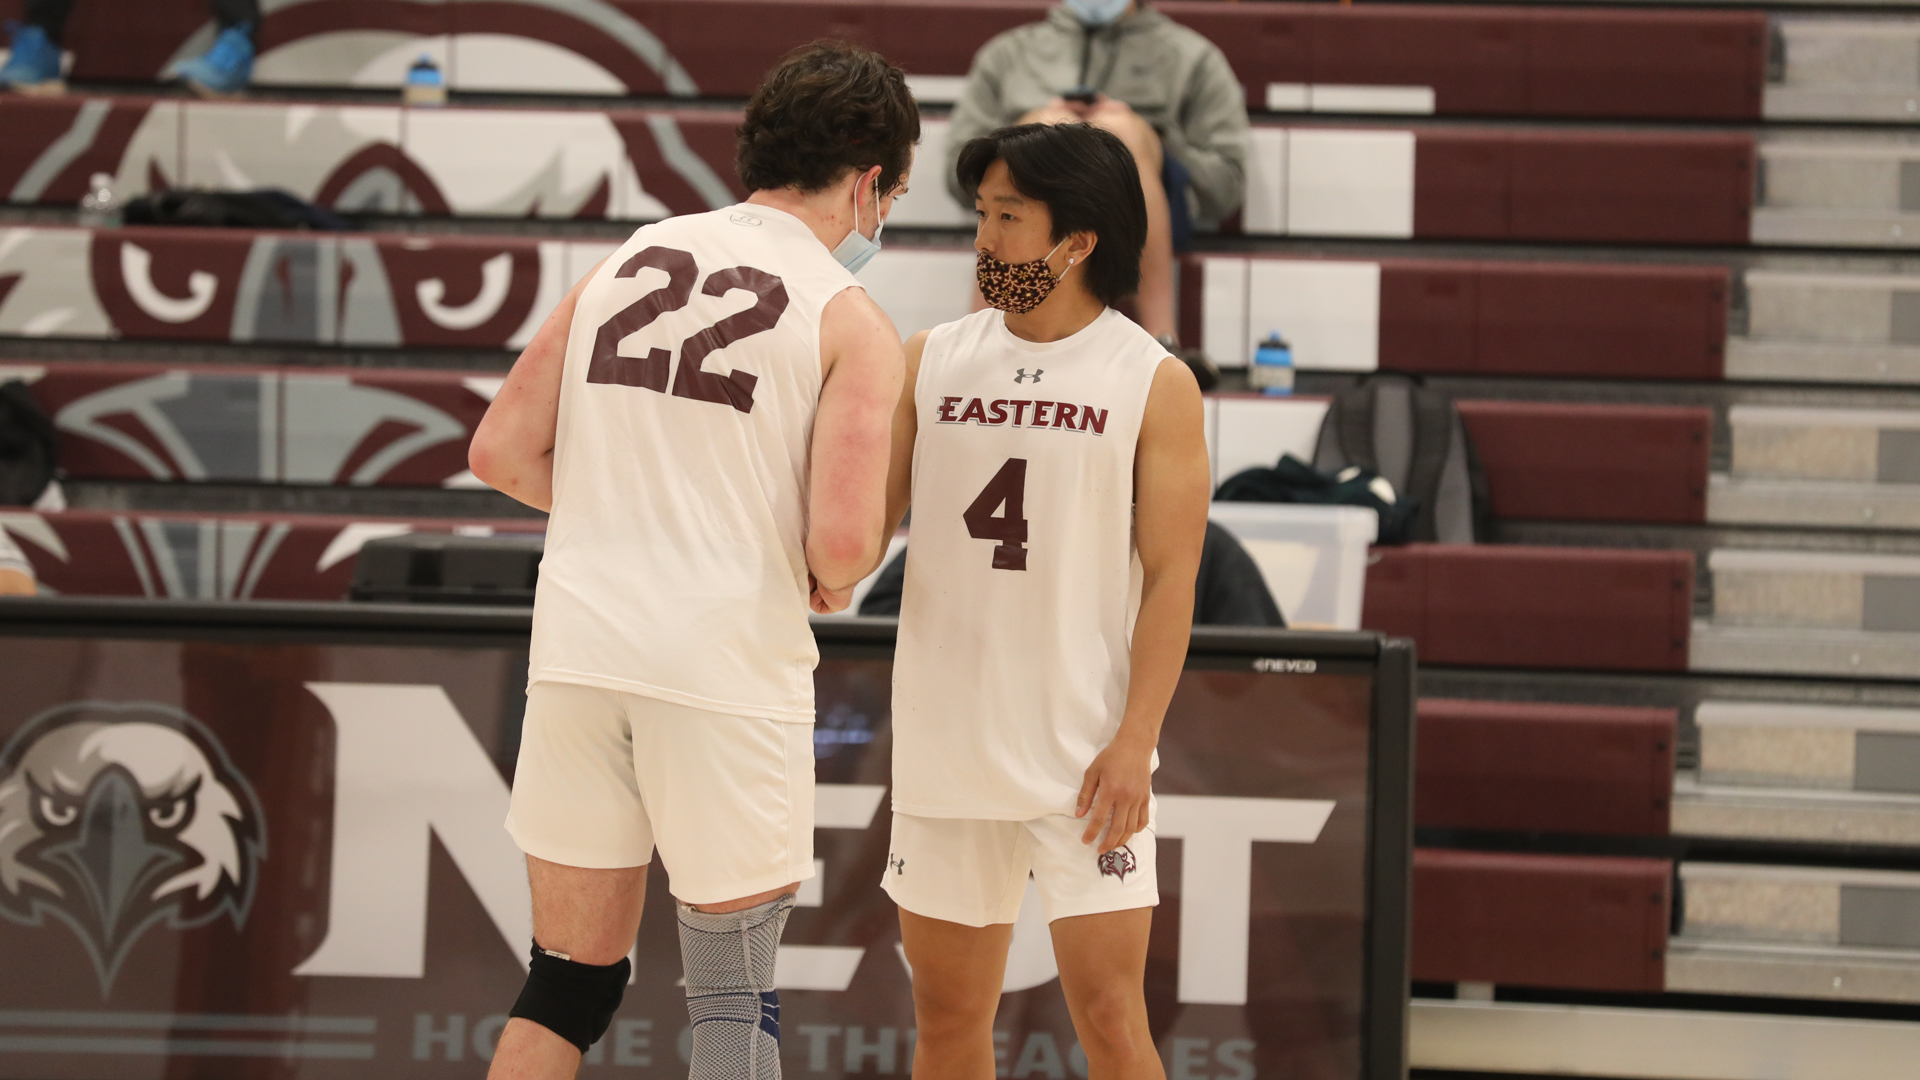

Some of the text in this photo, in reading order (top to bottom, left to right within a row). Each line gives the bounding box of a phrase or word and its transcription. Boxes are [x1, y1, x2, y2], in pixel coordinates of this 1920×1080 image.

[586, 245, 790, 414] 22
[936, 395, 1109, 436] EASTERN
[962, 457, 1028, 571] 4
[292, 682, 1335, 1005] NT
[797, 1025, 917, 1075] TH
[992, 1031, 1257, 1080] AES
